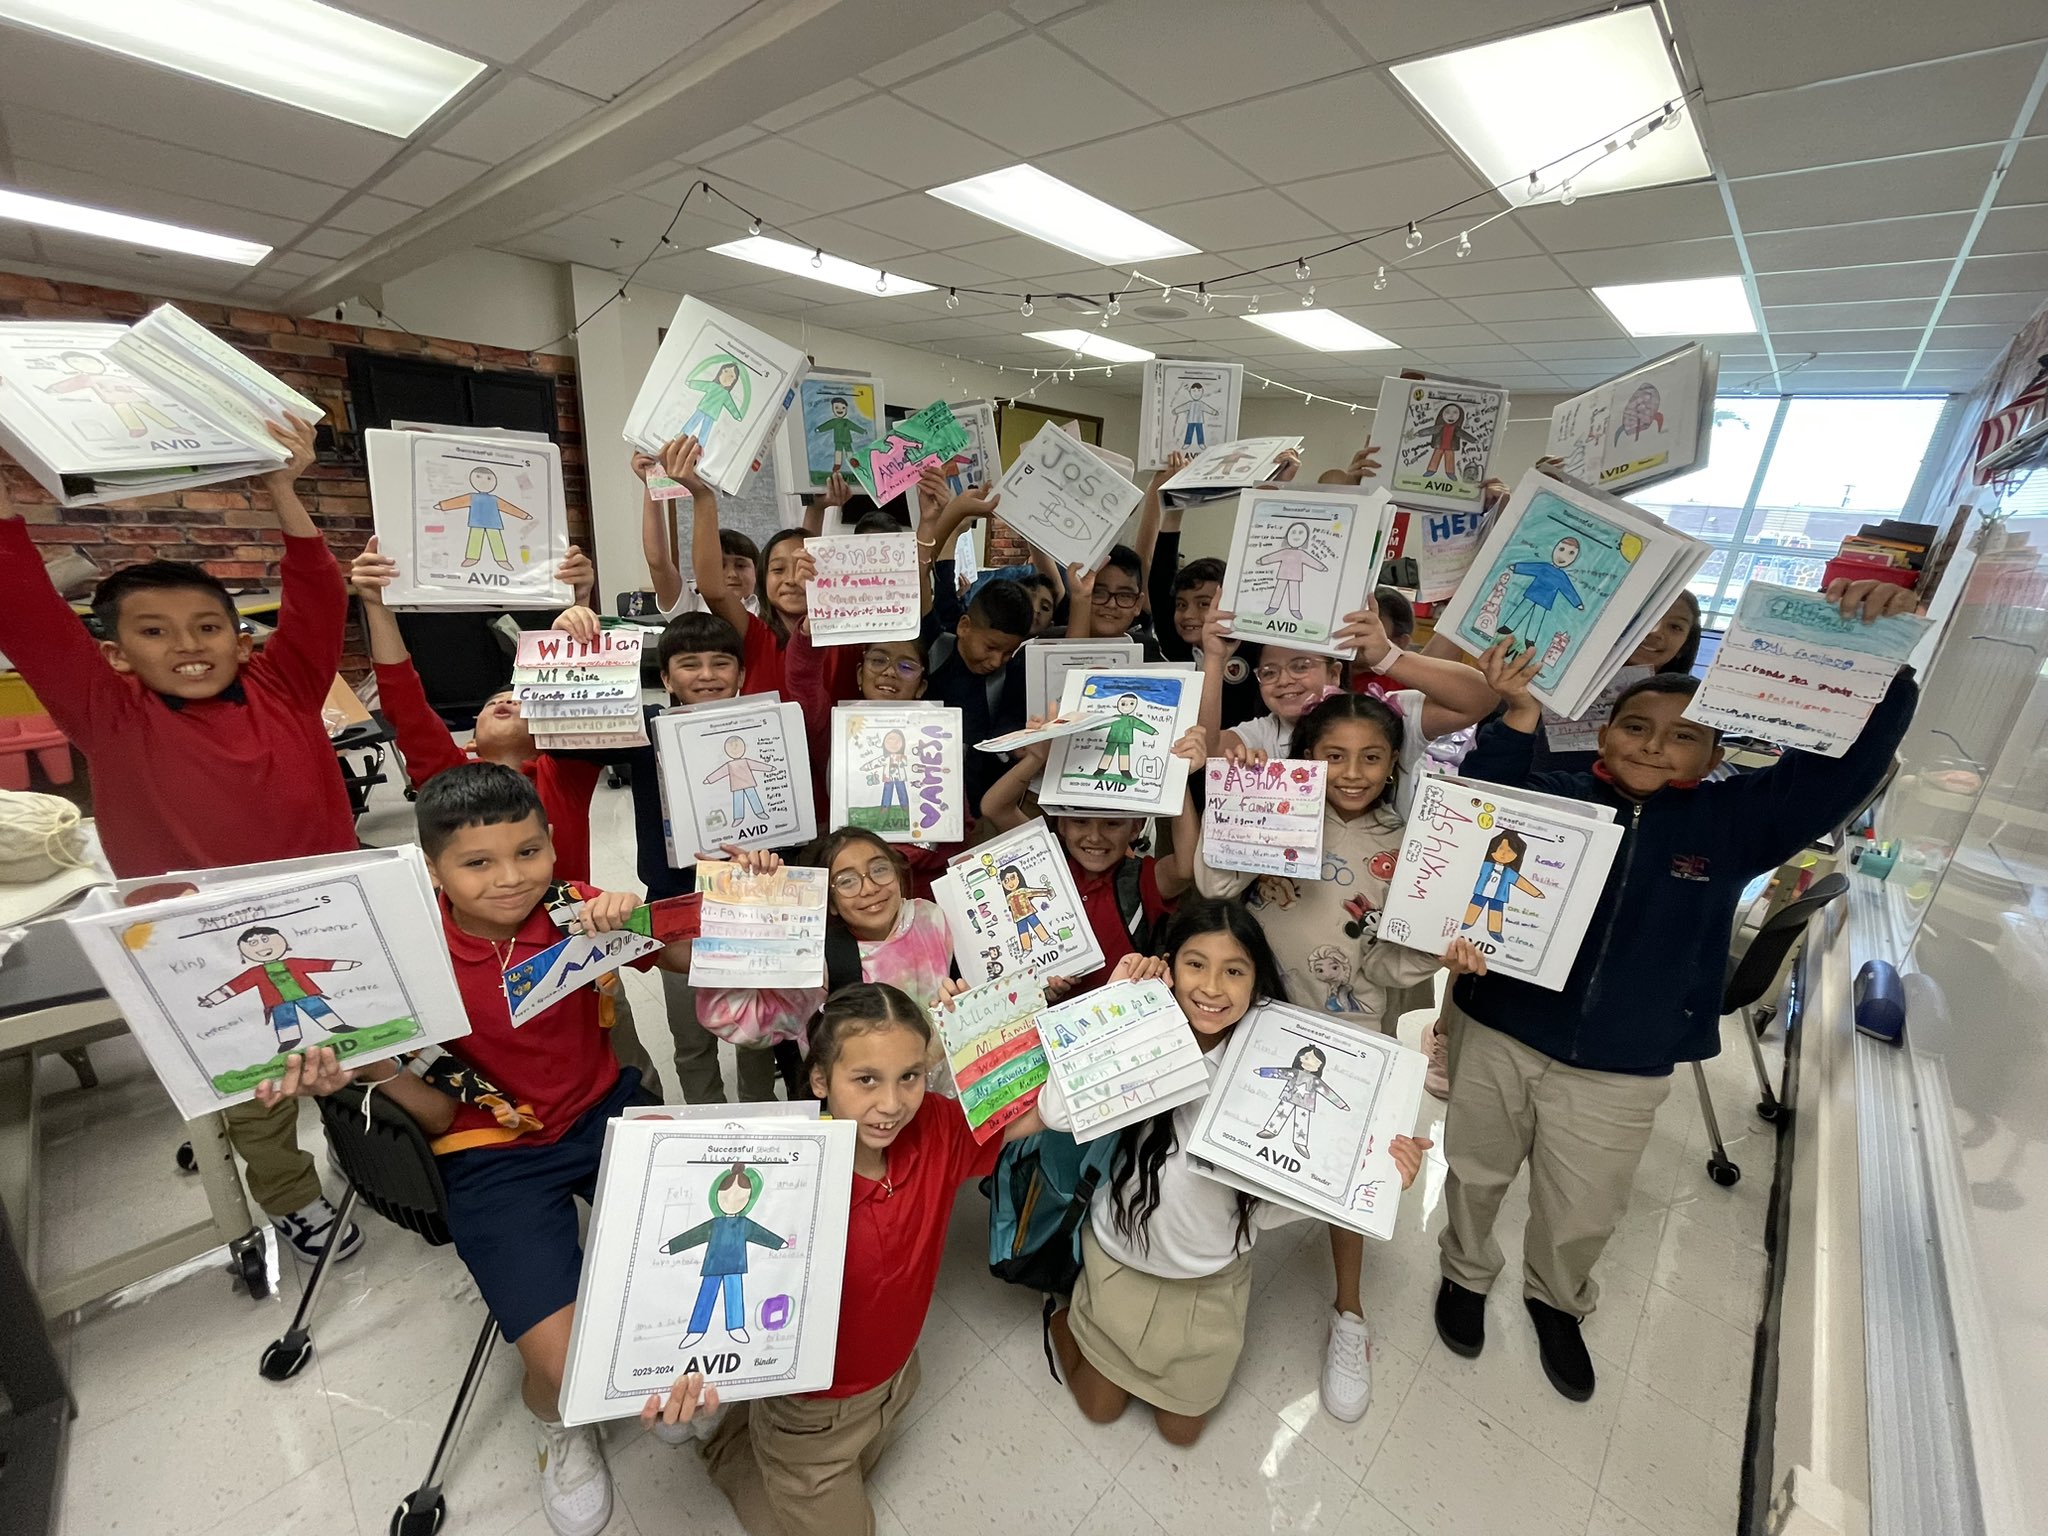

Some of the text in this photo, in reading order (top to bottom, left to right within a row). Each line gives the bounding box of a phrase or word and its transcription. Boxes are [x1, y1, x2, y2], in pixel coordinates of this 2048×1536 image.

[151, 439, 201, 451] AVID
[1425, 480, 1453, 493] AVID
[467, 572, 510, 586] AVID
[1266, 619, 1298, 633] AVID
[1094, 779, 1127, 793] AVID
[738, 824, 769, 841] AVID
[707, 1144, 754, 1154] Successful
[1256, 1145, 1302, 1175] AVID
[632, 1352, 779, 1377] 2023-2024 AVID Binder
